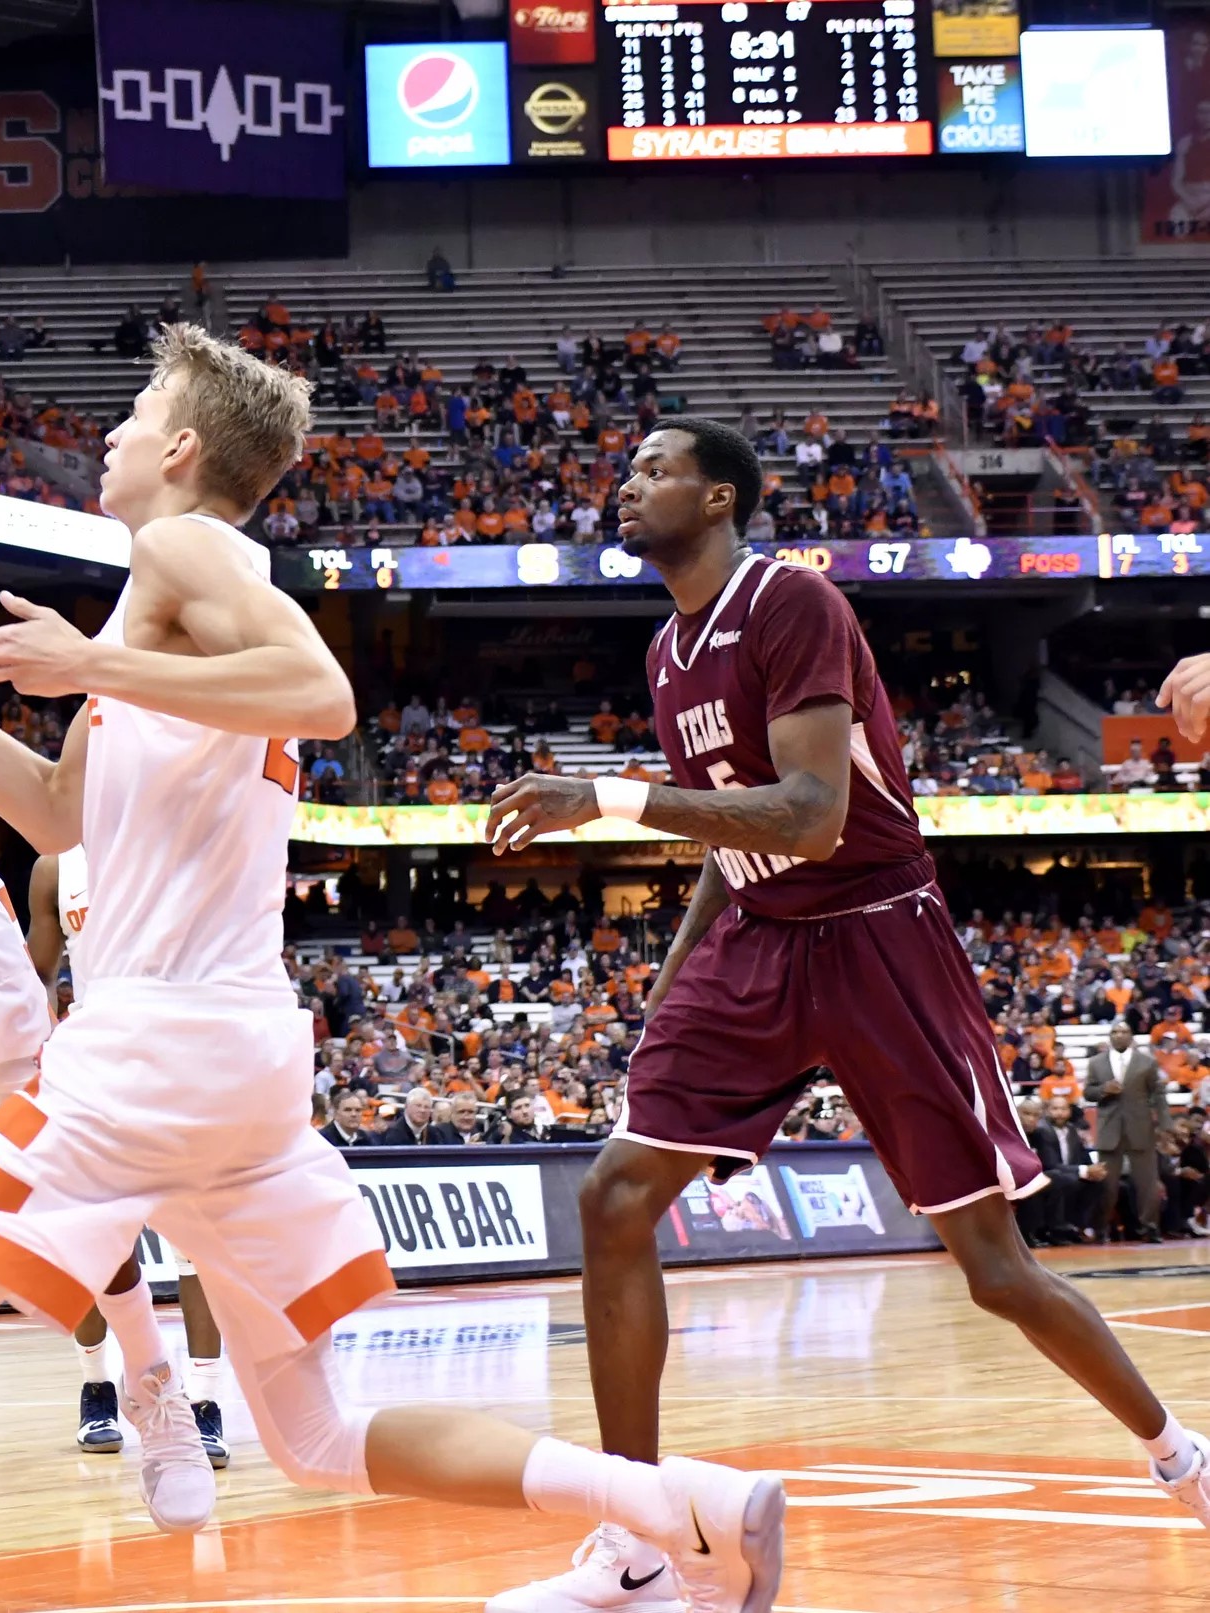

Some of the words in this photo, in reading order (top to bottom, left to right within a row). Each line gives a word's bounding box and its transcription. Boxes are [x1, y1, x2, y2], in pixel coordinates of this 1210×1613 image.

[622, 38, 640, 54] 11
[661, 38, 671, 54] 1
[841, 34, 852, 50] 1
[870, 33, 884, 49] 4
[621, 56, 641, 73] 21
[660, 55, 674, 72] 2
[841, 51, 854, 69] 2
[870, 51, 885, 67] 4
[902, 50, 916, 67] 2
[662, 73, 675, 90] 2
[841, 70, 855, 86] 4
[872, 69, 886, 86] 3
[949, 64, 1006, 86] TAKE
[662, 91, 675, 108] 3
[684, 91, 705, 108] 21
[873, 87, 887, 104] 3
[896, 87, 918, 104] 12
[962, 85, 996, 105] ME
[663, 110, 676, 126] 3
[687, 109, 705, 126] 11
[963, 105, 996, 124] TO
[632, 130, 782, 157] SYRACUSE
[941, 124, 1020, 148] CROUSE
[1157, 533, 1203, 553] TOL
[309, 549, 353, 570] TOL
[868, 543, 911, 573] 57
[1020, 553, 1081, 573] POSS
[1118, 553, 1133, 575] 7
[1172, 553, 1189, 574] 3
[324, 568, 340, 589] 2
[676, 699, 734, 759] TEXAS
[438, 1181, 534, 1248] BAR.
